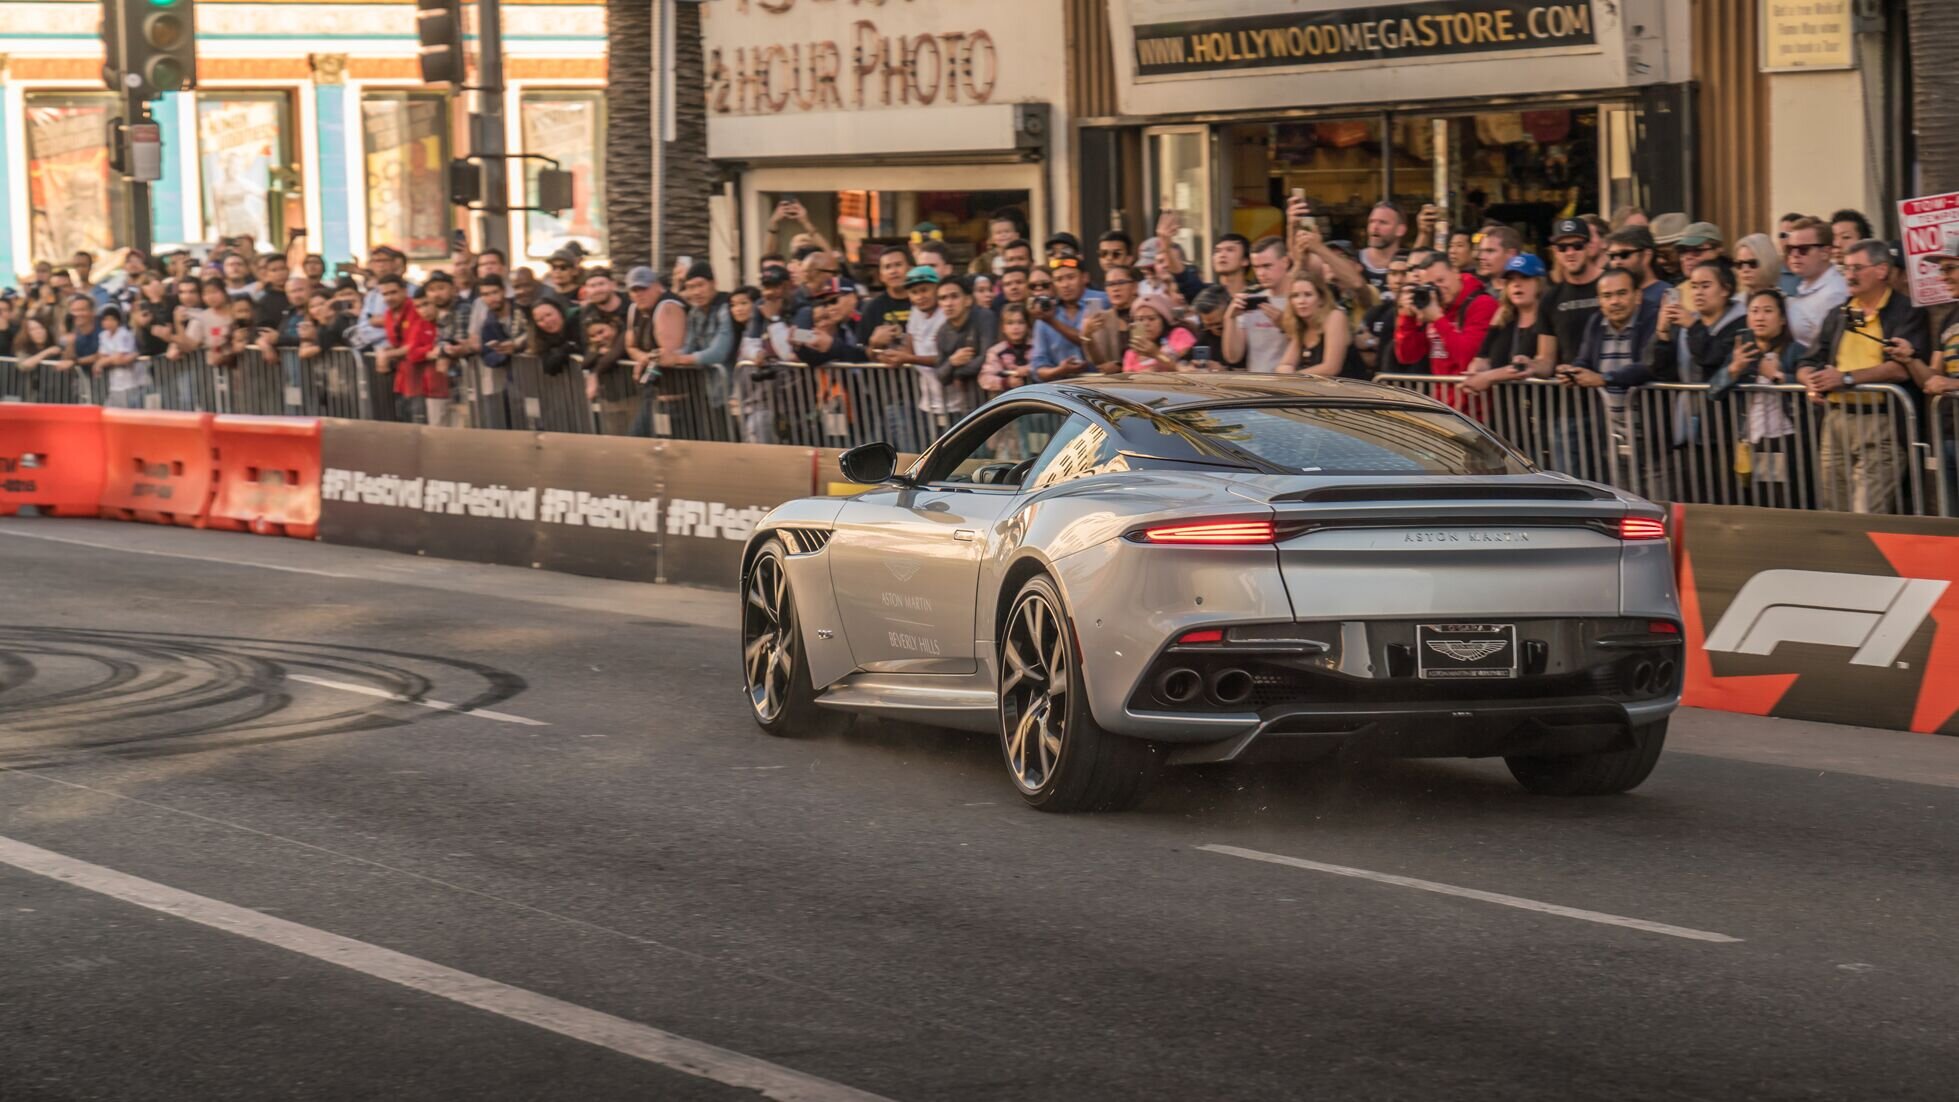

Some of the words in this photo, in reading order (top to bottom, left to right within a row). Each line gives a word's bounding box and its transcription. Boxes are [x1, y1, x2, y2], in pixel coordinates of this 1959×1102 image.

[1137, 4, 1591, 65] WWW.HOLLYWOODMEGASTORE.COM
[853, 20, 996, 110] PHOTO
[1910, 227, 1940, 253] NO
[1404, 532, 1459, 542] ASTON
[881, 592, 902, 607] ASTON
[904, 595, 932, 611] MARTIN
[1702, 568, 1952, 668] F1
[888, 631, 917, 651] BEVERLY
[919, 636, 940, 655] HILLS
